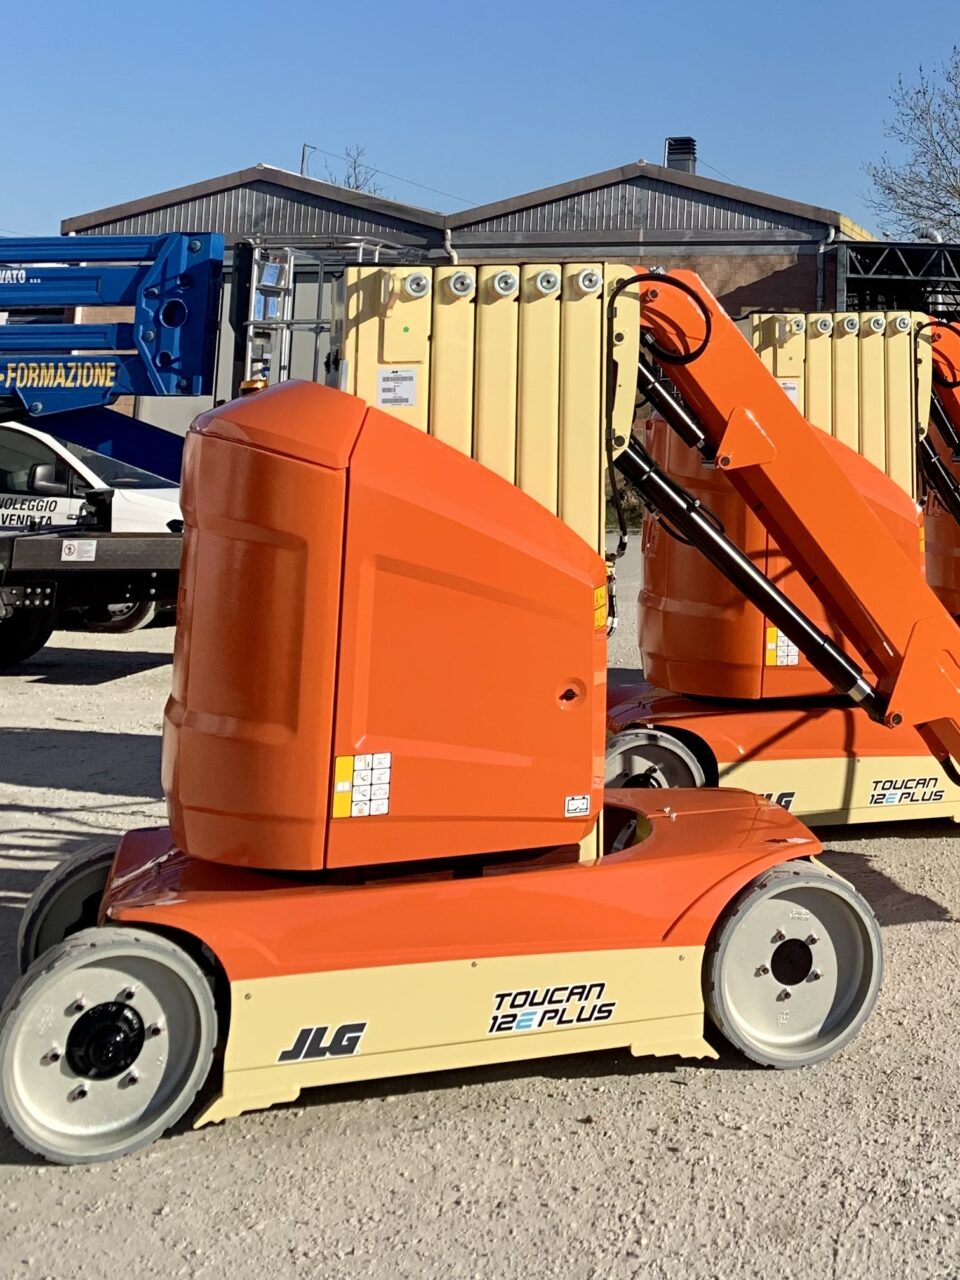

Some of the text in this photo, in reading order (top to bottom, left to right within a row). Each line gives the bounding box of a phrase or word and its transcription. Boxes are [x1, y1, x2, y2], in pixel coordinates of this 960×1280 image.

[5, 362, 116, 388] FORMAZIONE
[1, 513, 52, 526] VENDTA
[872, 778, 938, 791] TOUCAN
[495, 983, 605, 1007] TOUCAN
[278, 1022, 367, 1061] JLG
